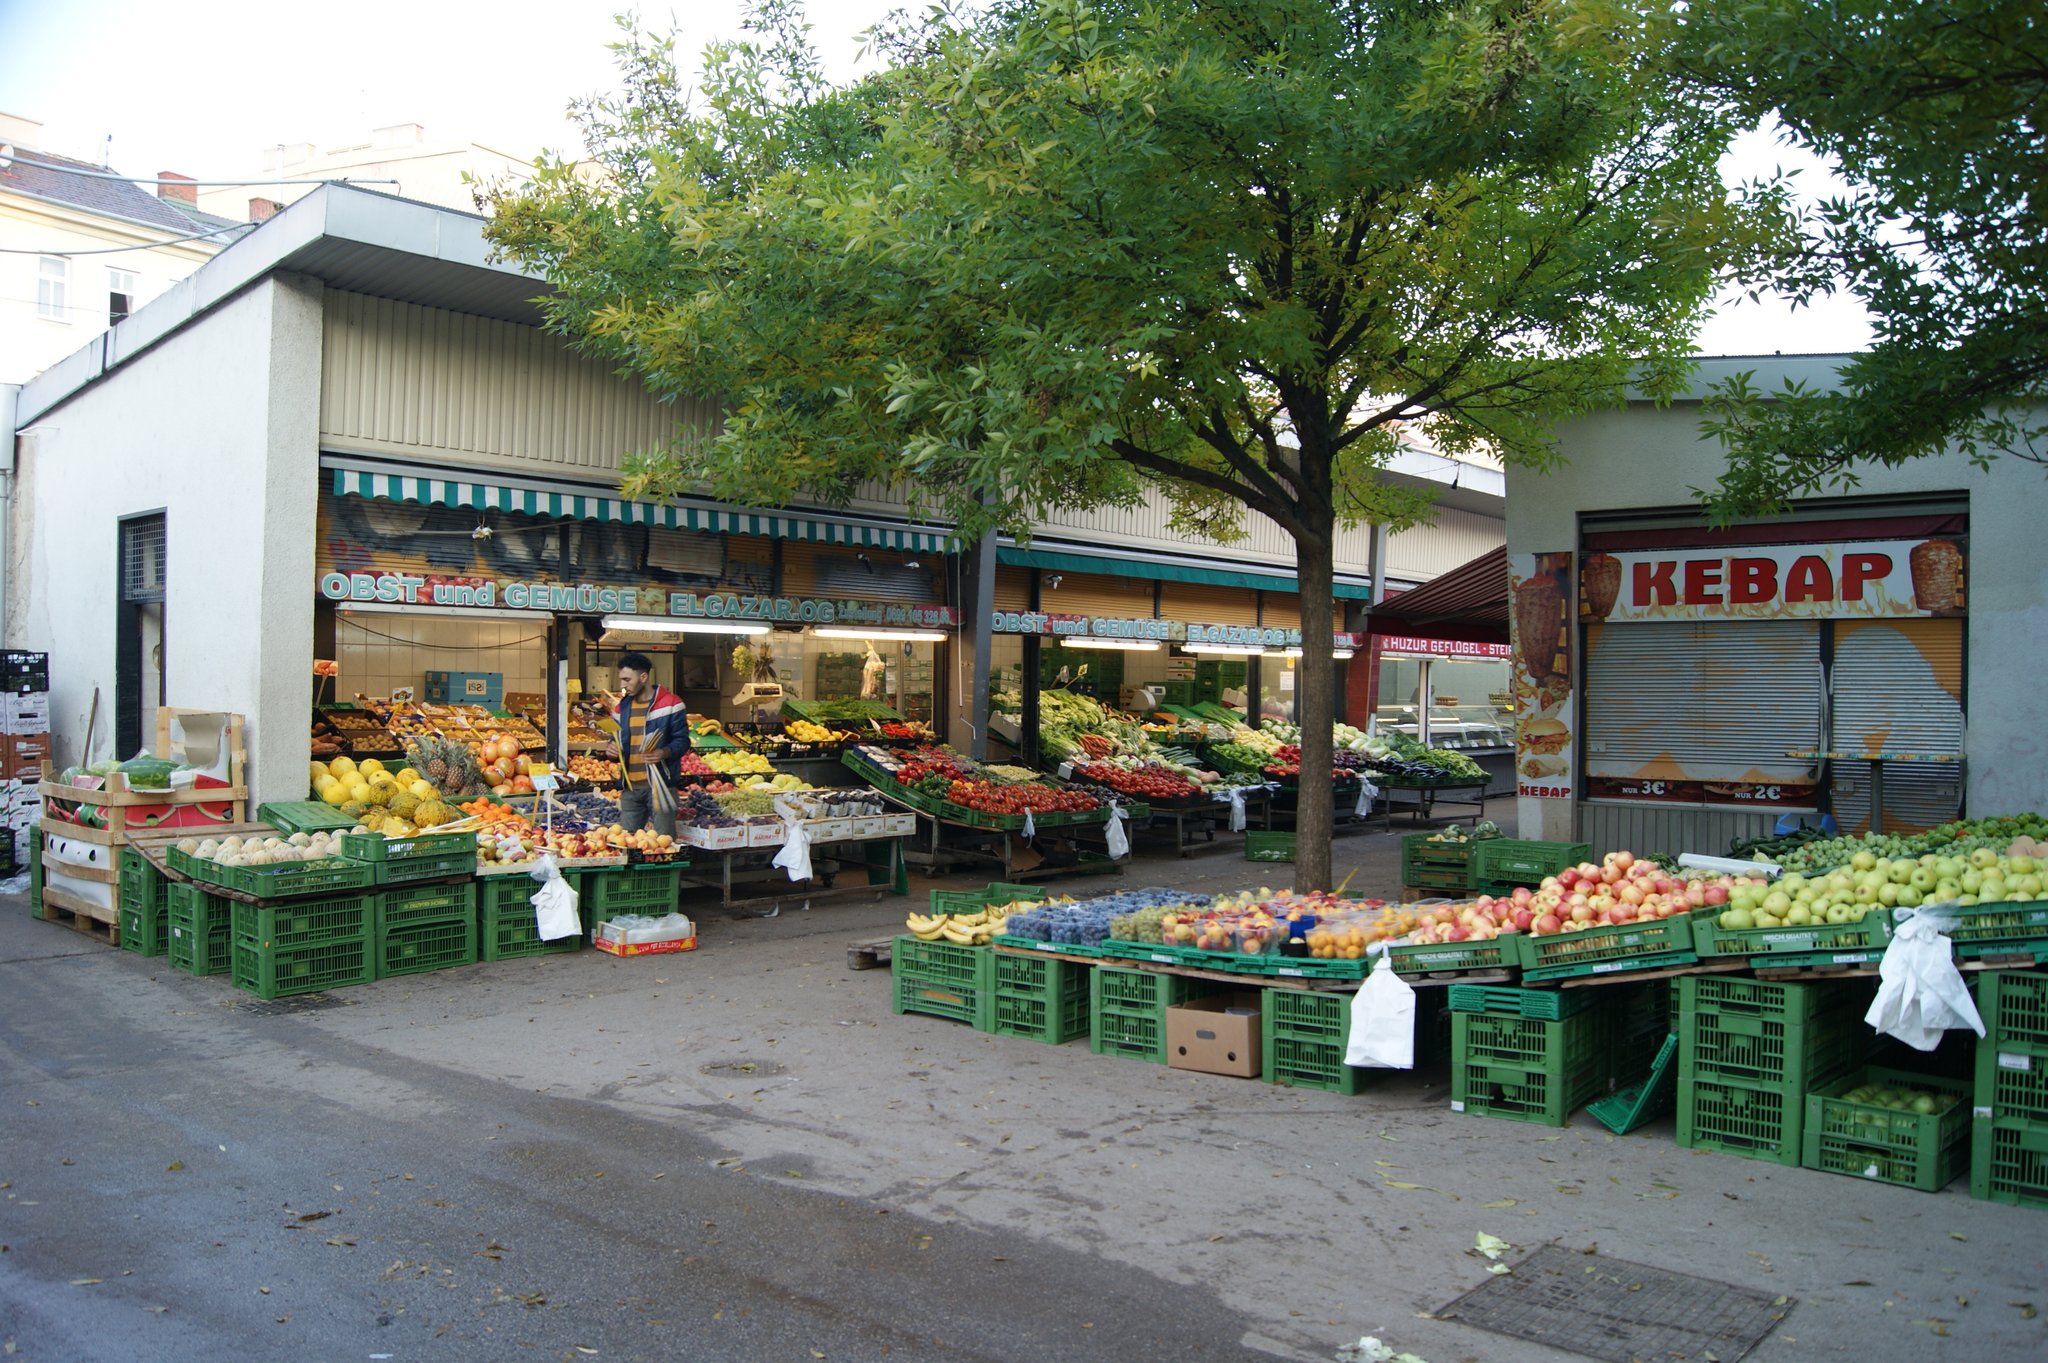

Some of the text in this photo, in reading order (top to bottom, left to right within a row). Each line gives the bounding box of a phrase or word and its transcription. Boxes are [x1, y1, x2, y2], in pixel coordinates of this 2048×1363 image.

[1632, 553, 1893, 607] KEBAP
[321, 572, 835, 623] OBST und GEMÜSE ELGAZAR.OG
[991, 612, 1048, 634] OBST
[1052, 618, 1088, 636] und
[1093, 617, 1169, 640] GEMÜSE
[1390, 637, 1428, 653] HUZUR
[1519, 784, 1571, 798] KEBAP
[1622, 780, 1665, 795] NUR 3€
[1734, 785, 1781, 800] NUR 2€
